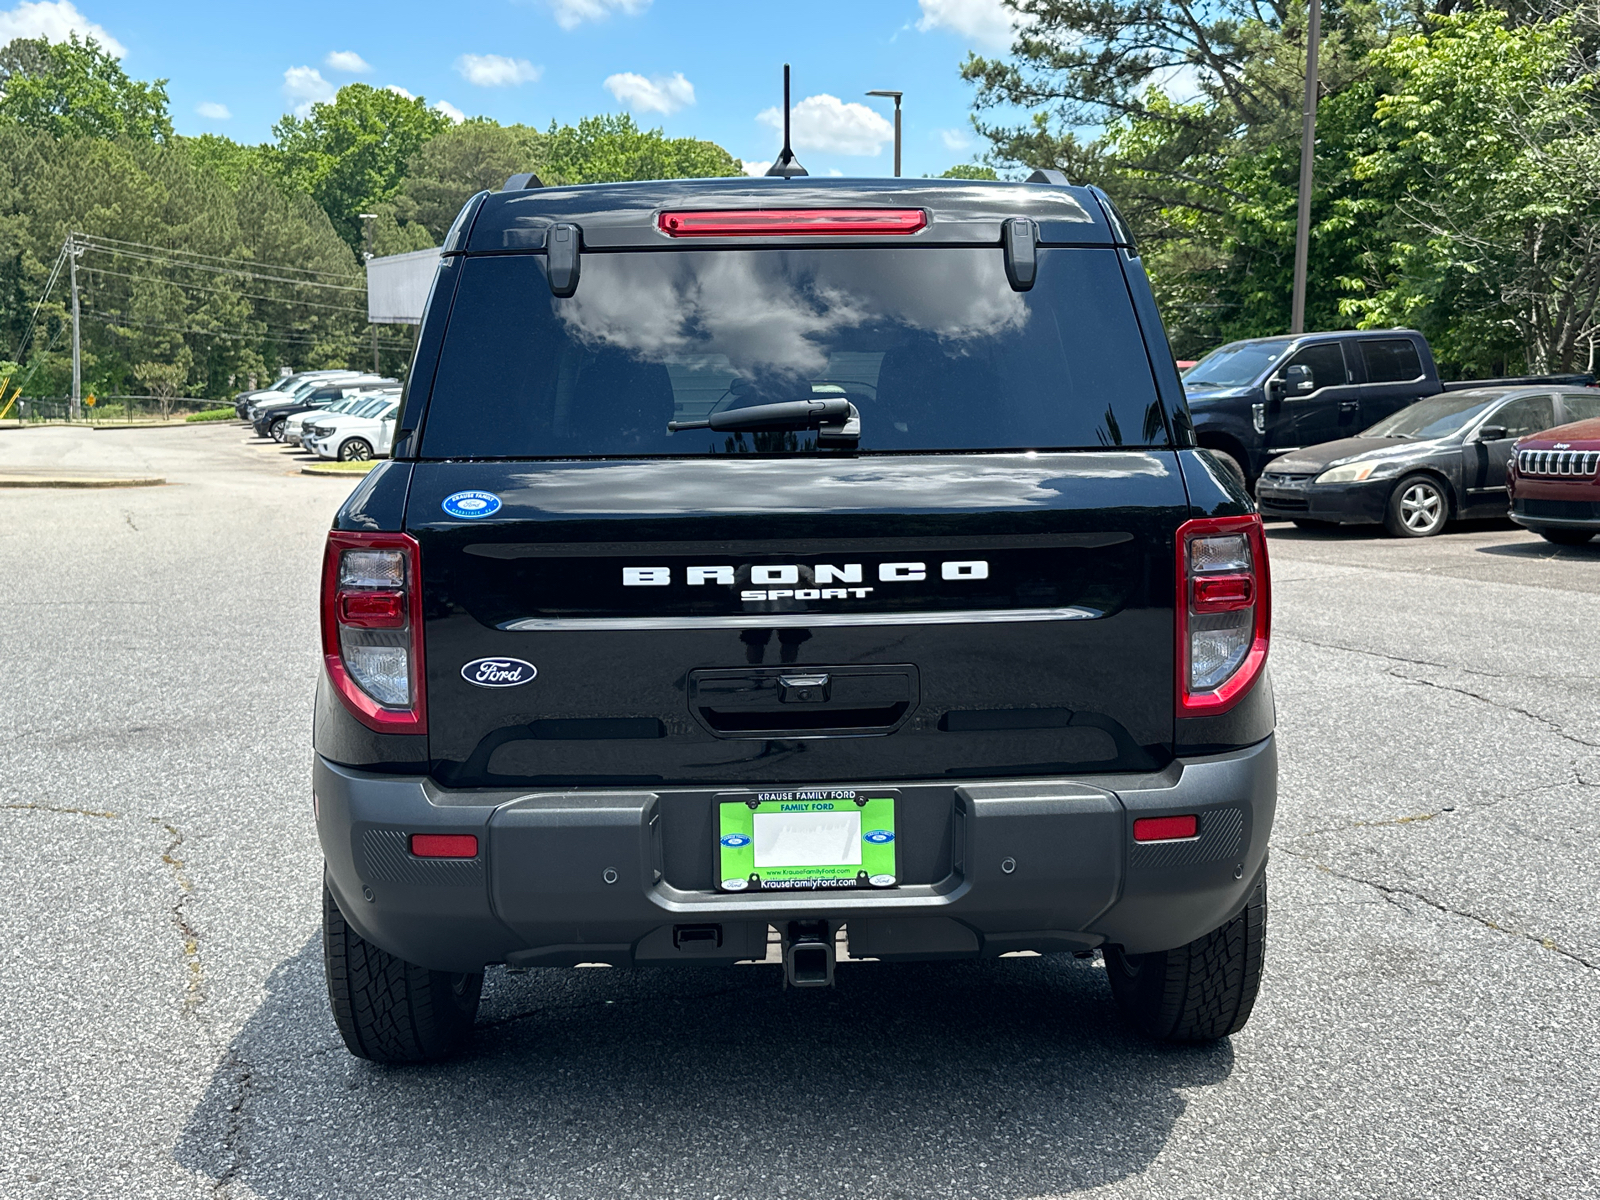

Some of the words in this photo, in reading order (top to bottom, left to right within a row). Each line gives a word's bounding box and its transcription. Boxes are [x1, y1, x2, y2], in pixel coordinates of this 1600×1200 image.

[462, 500, 481, 508] Ford
[622, 560, 989, 586] BRONCO
[741, 587, 874, 601] SPORT
[475, 661, 522, 682] Ford
[758, 791, 793, 801] KRAUSE
[796, 791, 828, 800] FAMILY
[831, 790, 856, 799] FORD
[780, 803, 809, 811] FAMILY
[766, 868, 851, 877] www.KrauseFamilyFord.com
[760, 878, 857, 890] KrauseFamilyFord.com
[874, 876, 890, 884] Ford
